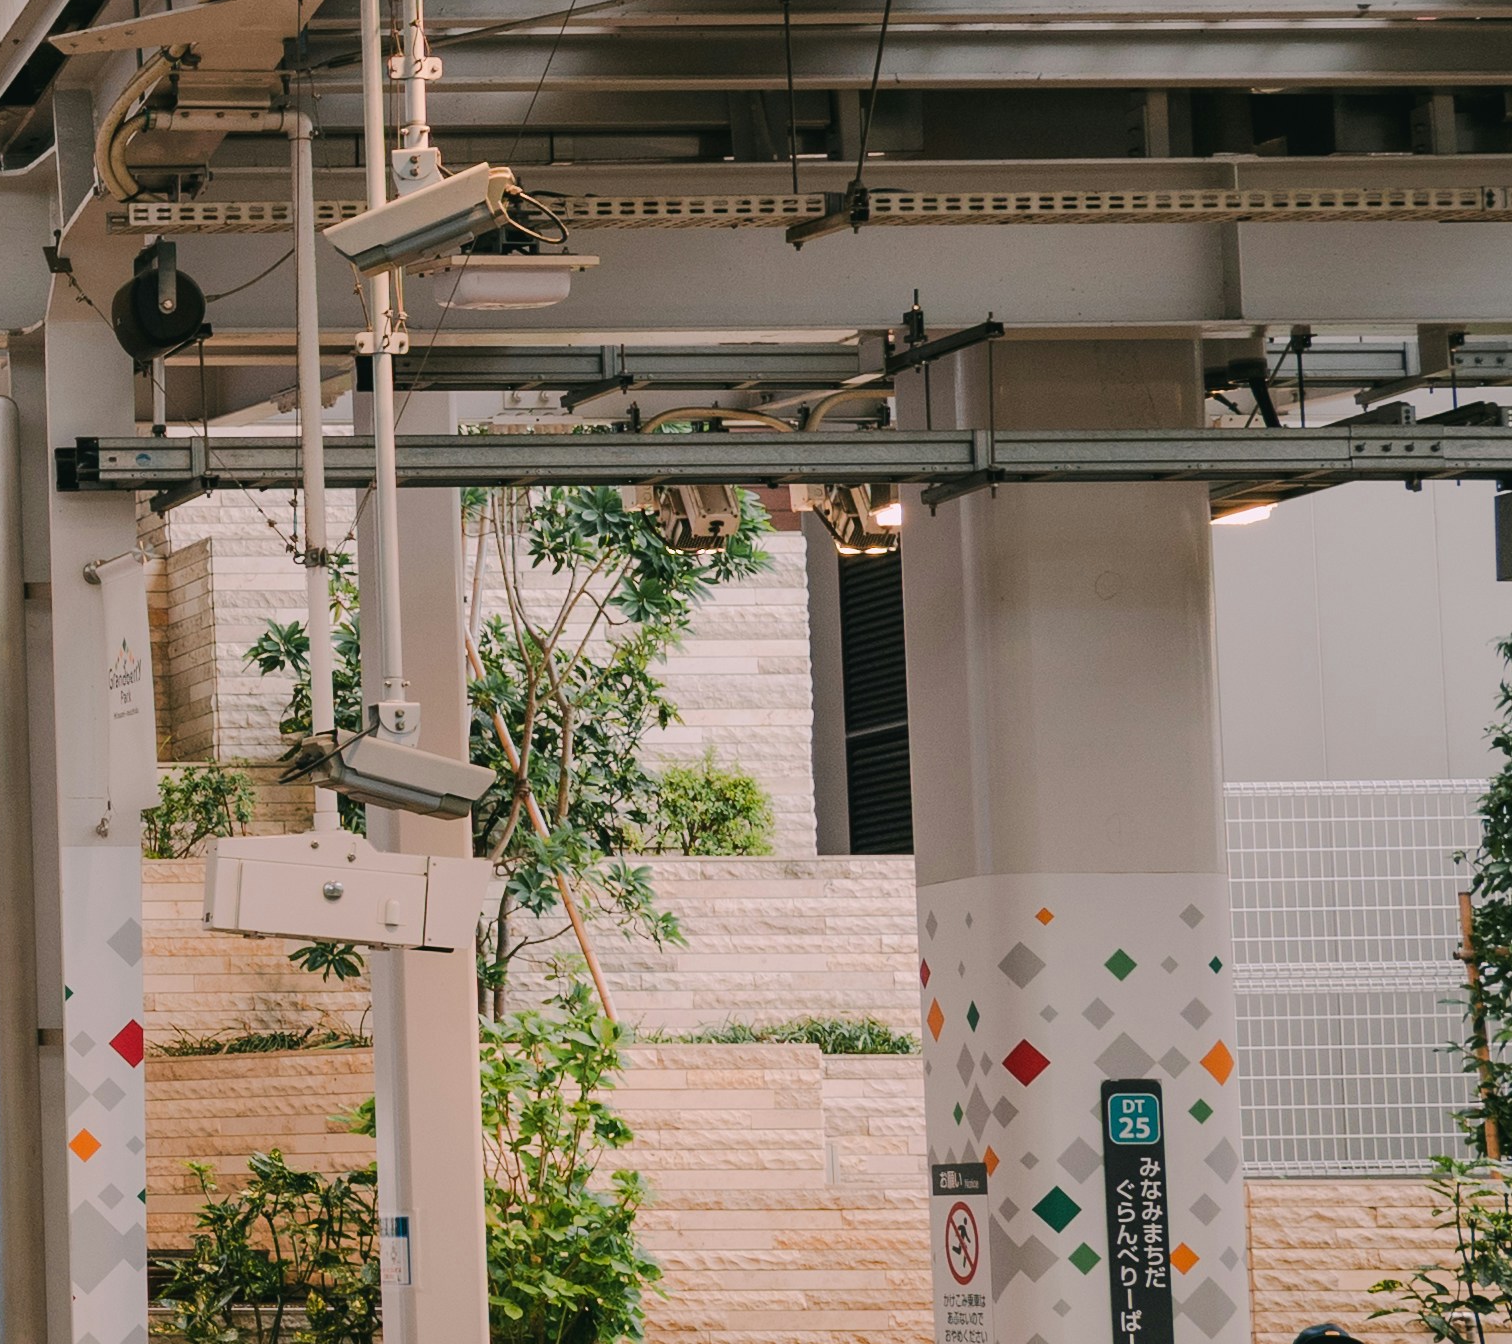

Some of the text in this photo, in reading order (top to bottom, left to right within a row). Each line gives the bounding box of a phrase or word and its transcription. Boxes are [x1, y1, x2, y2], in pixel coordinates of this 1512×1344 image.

[1122, 1099, 1145, 1114] DT
[1118, 1117, 1151, 1139] 25
[1139, 1157, 1166, 1288] みなみまちだ
